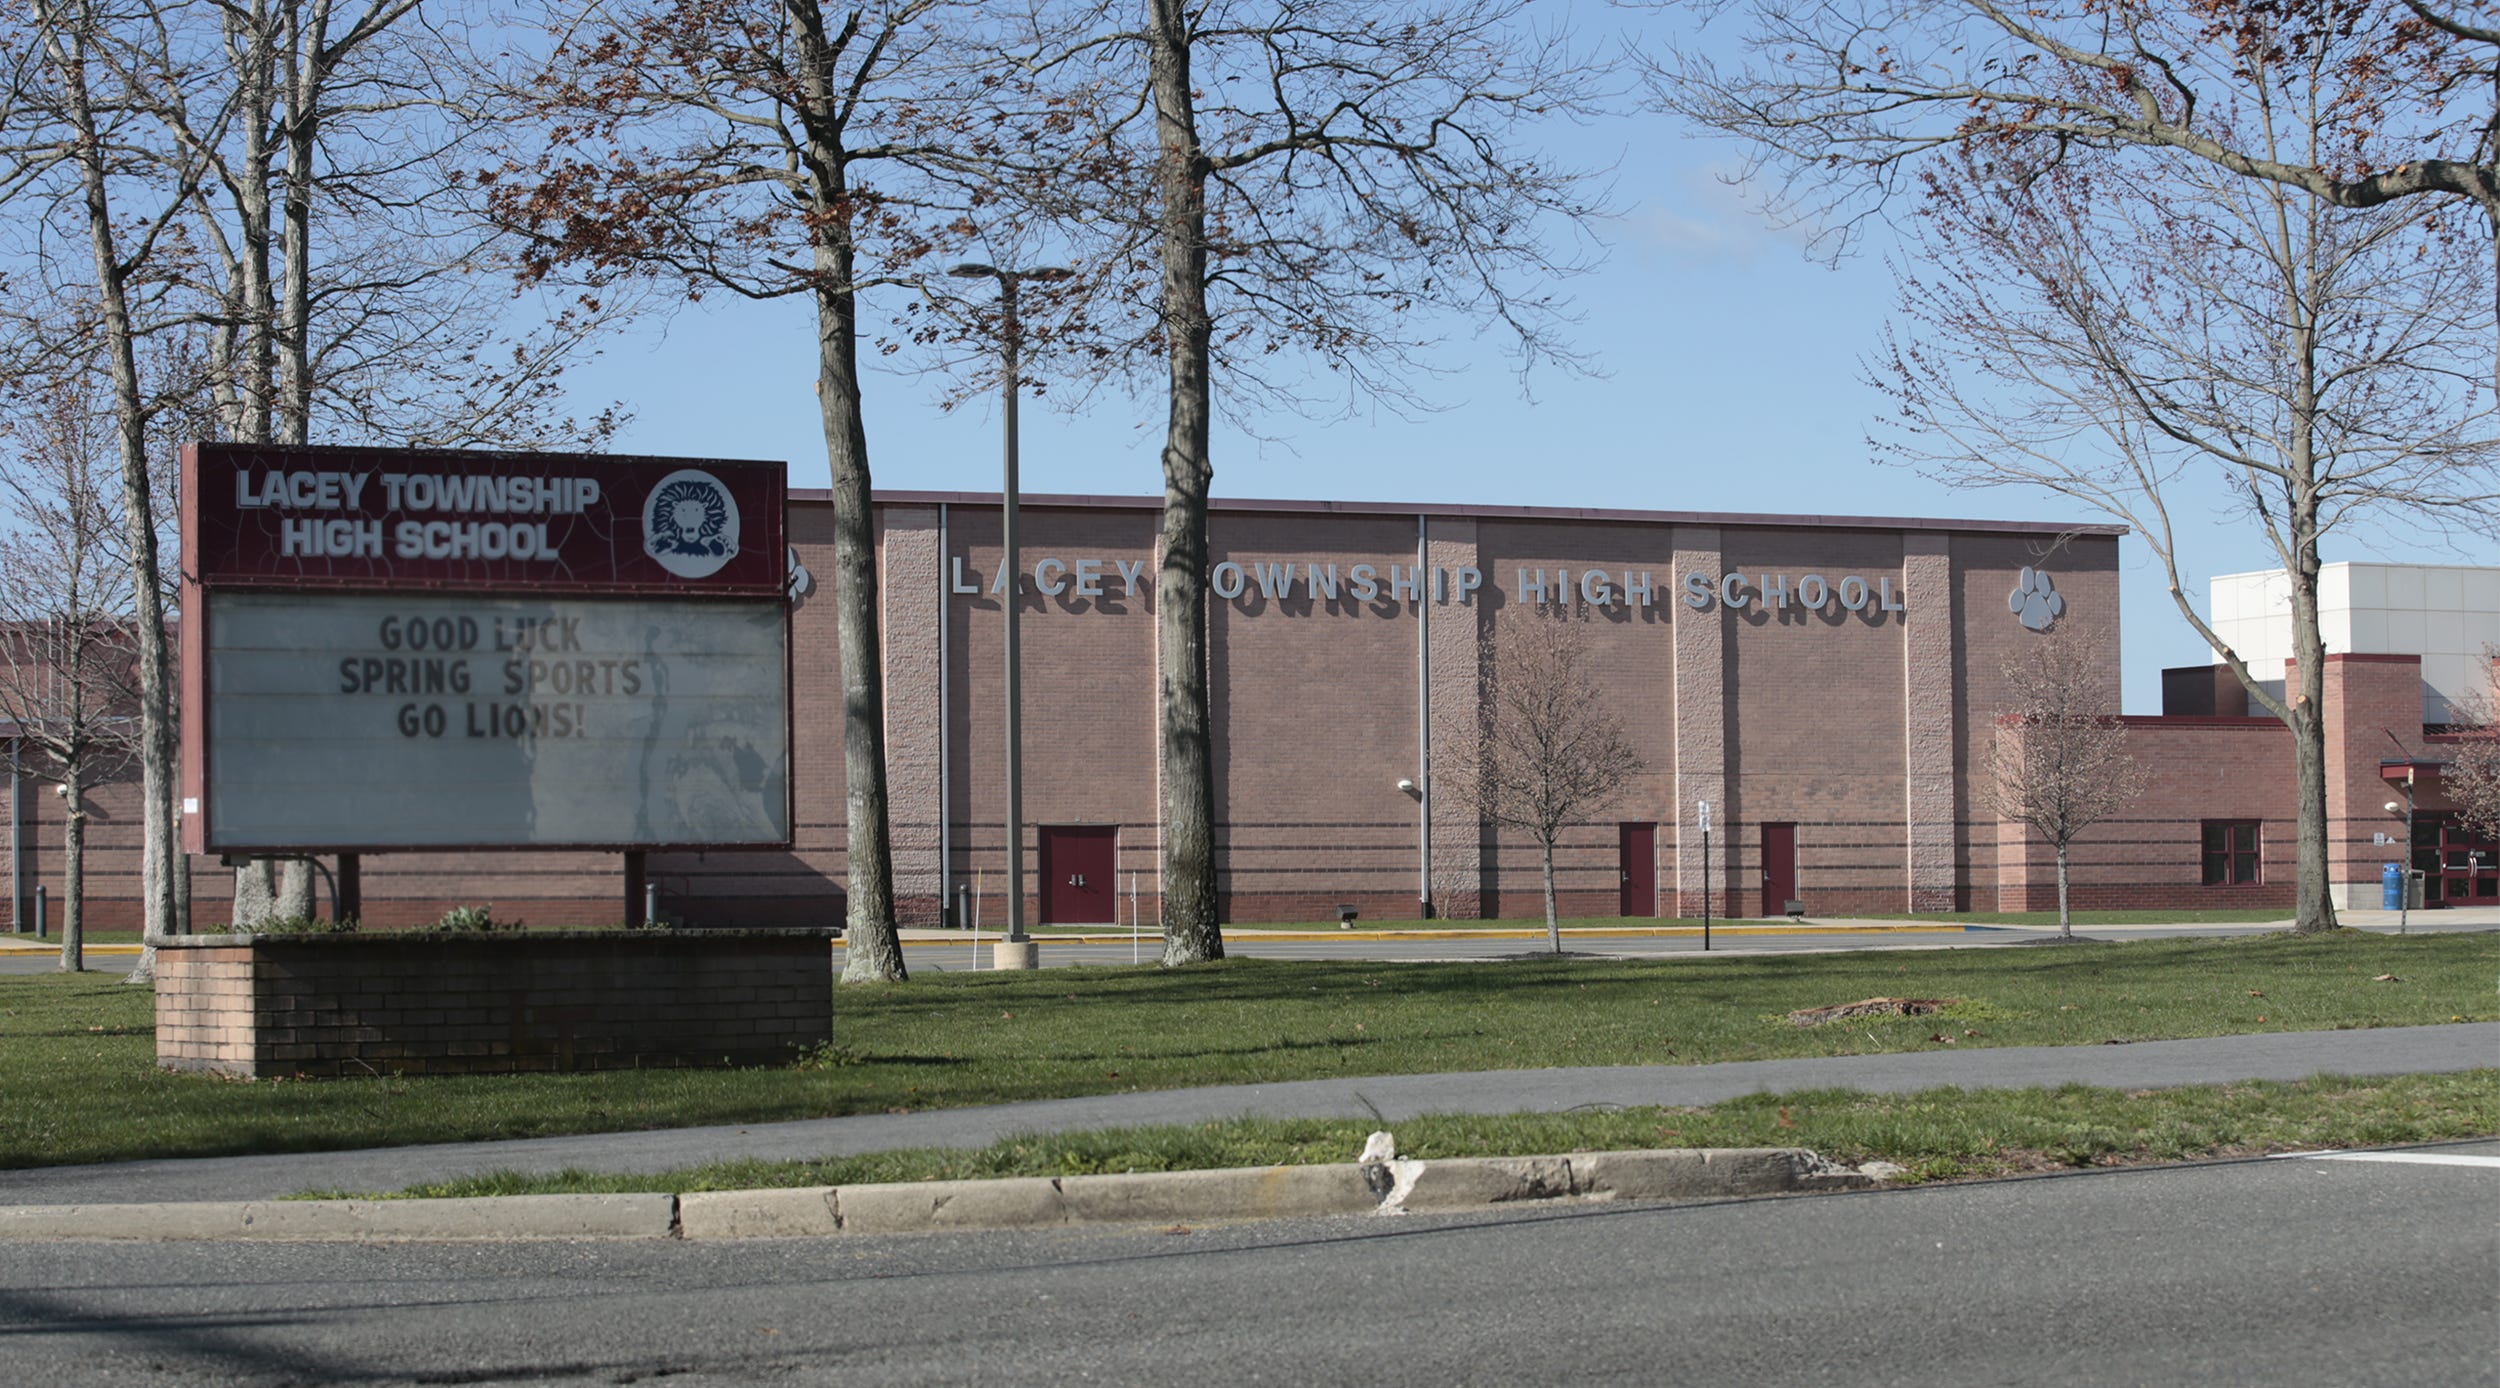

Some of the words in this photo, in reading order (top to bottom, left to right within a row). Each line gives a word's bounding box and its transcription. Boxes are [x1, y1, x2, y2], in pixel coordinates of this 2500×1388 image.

[237, 470, 369, 511] LACEY
[380, 473, 600, 514] TOWNSHIP
[281, 518, 383, 559] HIGH
[395, 520, 559, 561] SCHOOL
[1212, 561, 1482, 602] OWNSHIP
[1518, 568, 1651, 606] HIGH
[1684, 571, 1903, 611] SCHOOL
[380, 615, 478, 651] GOOD
[495, 617, 582, 652] LUCK
[340, 657, 471, 694] SPRING
[504, 659, 641, 695] SPORTS
[398, 703, 446, 738] GO
[467, 702, 585, 738] LIONS!
